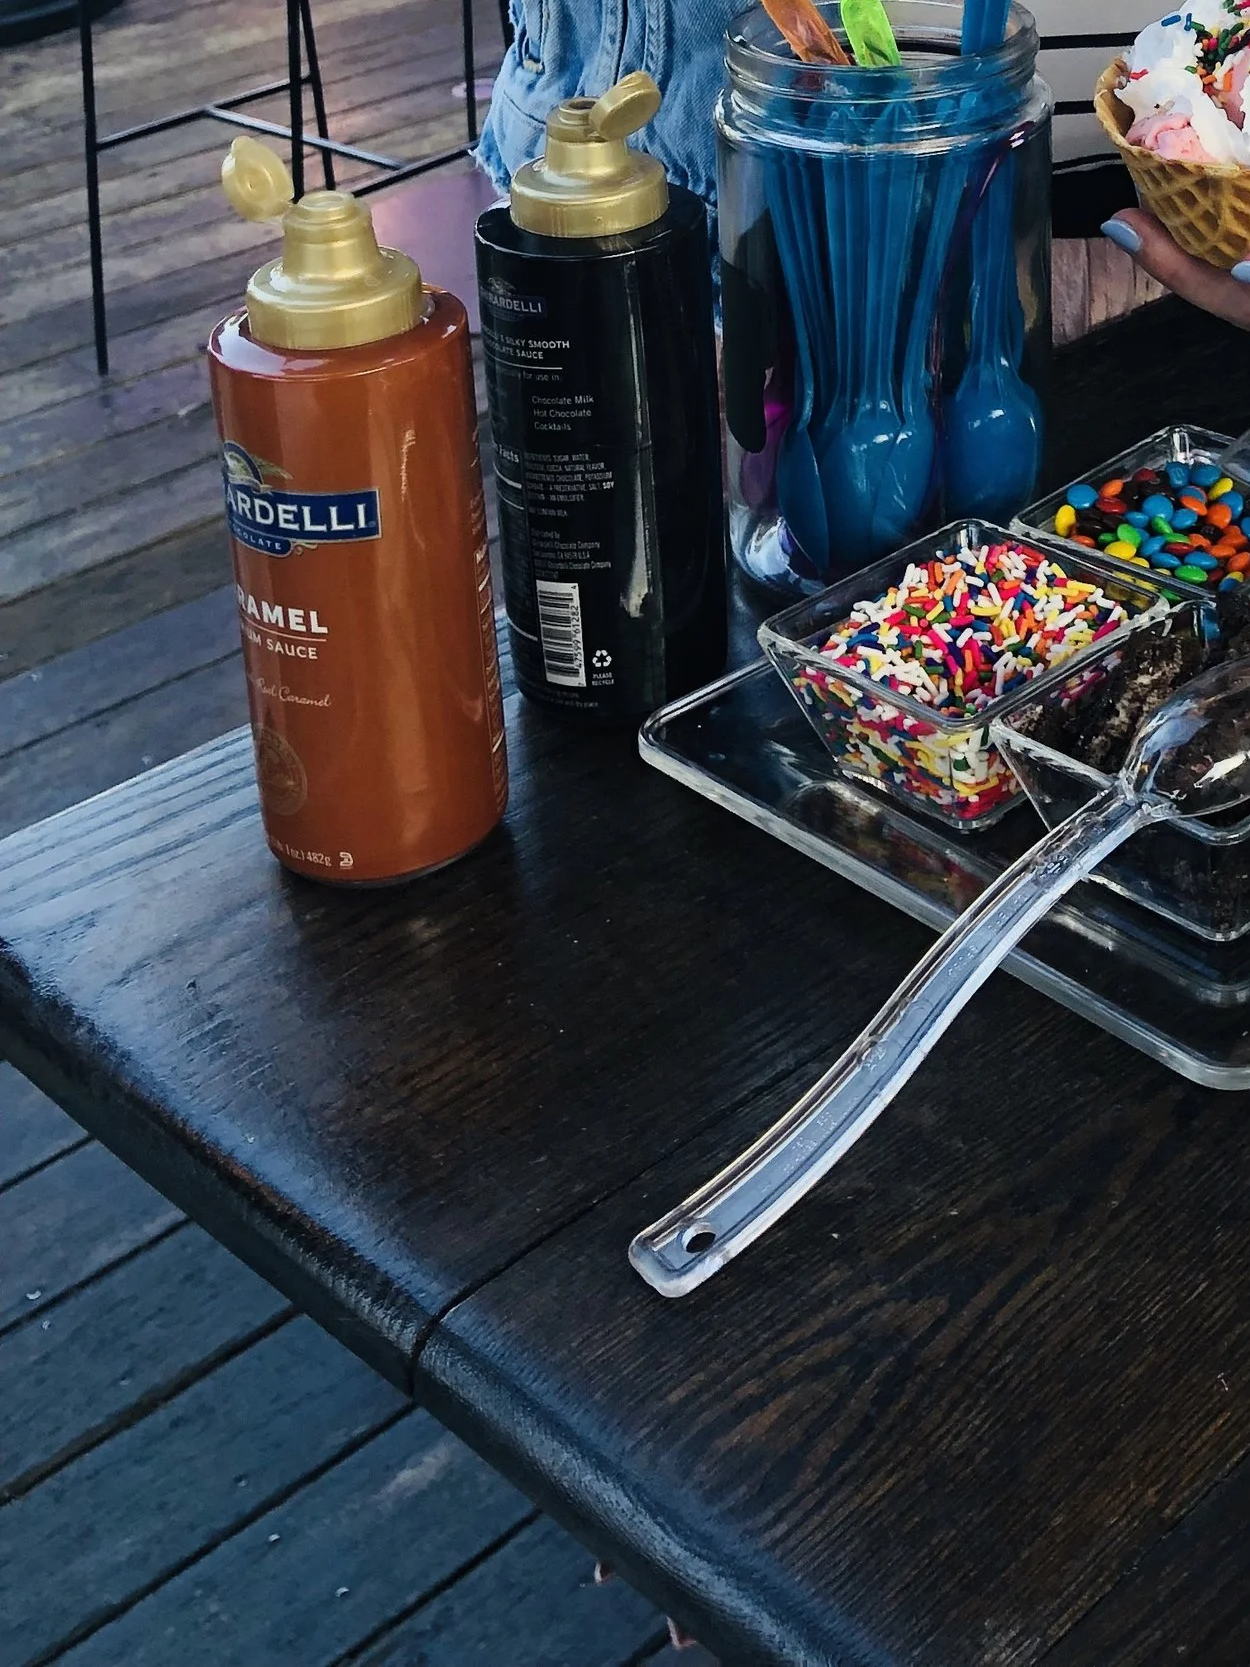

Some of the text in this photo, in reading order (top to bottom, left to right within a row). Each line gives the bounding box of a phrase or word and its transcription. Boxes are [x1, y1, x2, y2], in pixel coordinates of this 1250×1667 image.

[528, 340, 571, 349] SMOOTH
[516, 349, 544, 360] SAUCE
[532, 395, 594, 405] Chocolate Milk
[549, 409, 592, 419] Chocolate
[602, 481, 614, 490] SOY
[570, 605, 581, 635] 61282
[266, 638, 318, 660] SAUCE
[279, 686, 332, 707] Caramel
